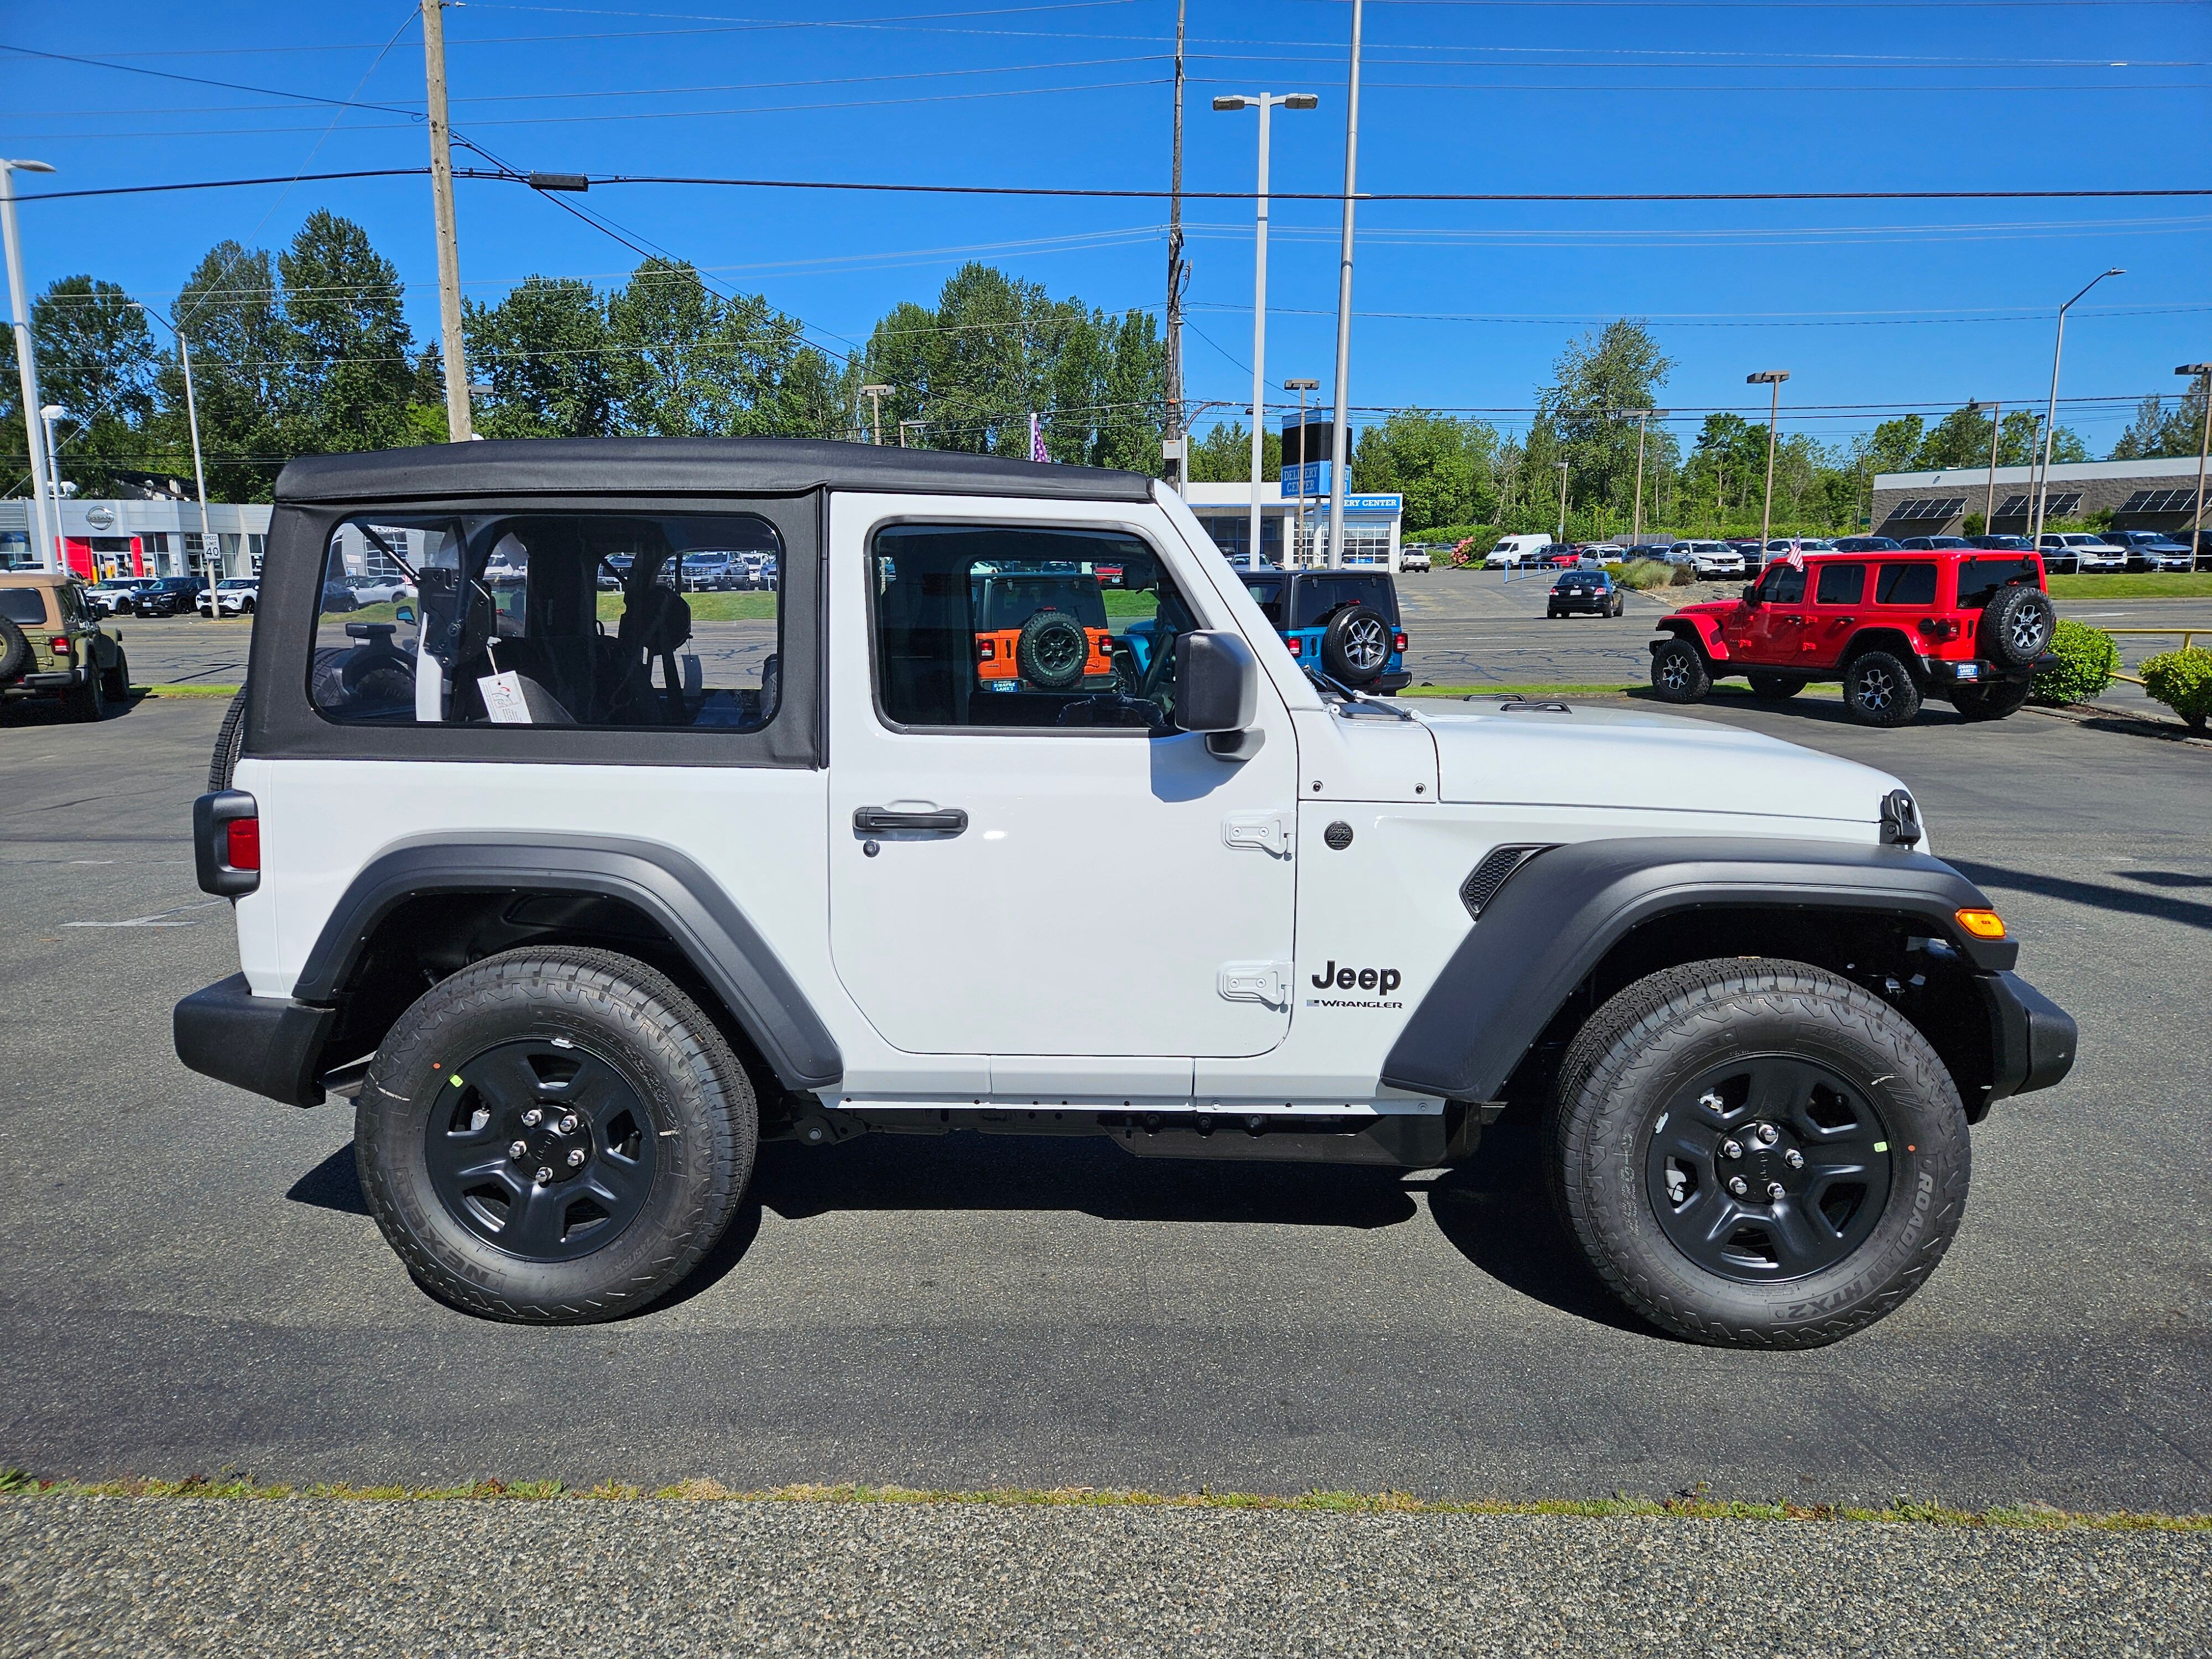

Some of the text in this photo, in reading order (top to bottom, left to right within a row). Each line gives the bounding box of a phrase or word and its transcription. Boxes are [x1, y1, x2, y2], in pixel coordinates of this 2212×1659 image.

[1284, 466, 1318, 481] DELIERY
[206, 547, 219, 556] 40
[1312, 960, 1401, 995] Jeep
[1321, 1000, 1403, 1009] WRANGLER
[1809, 1027, 1884, 1066] All-Weather
[394, 1182, 491, 1285] NEXEN
[1787, 1171, 1933, 1319] ROADIAN HTX2
